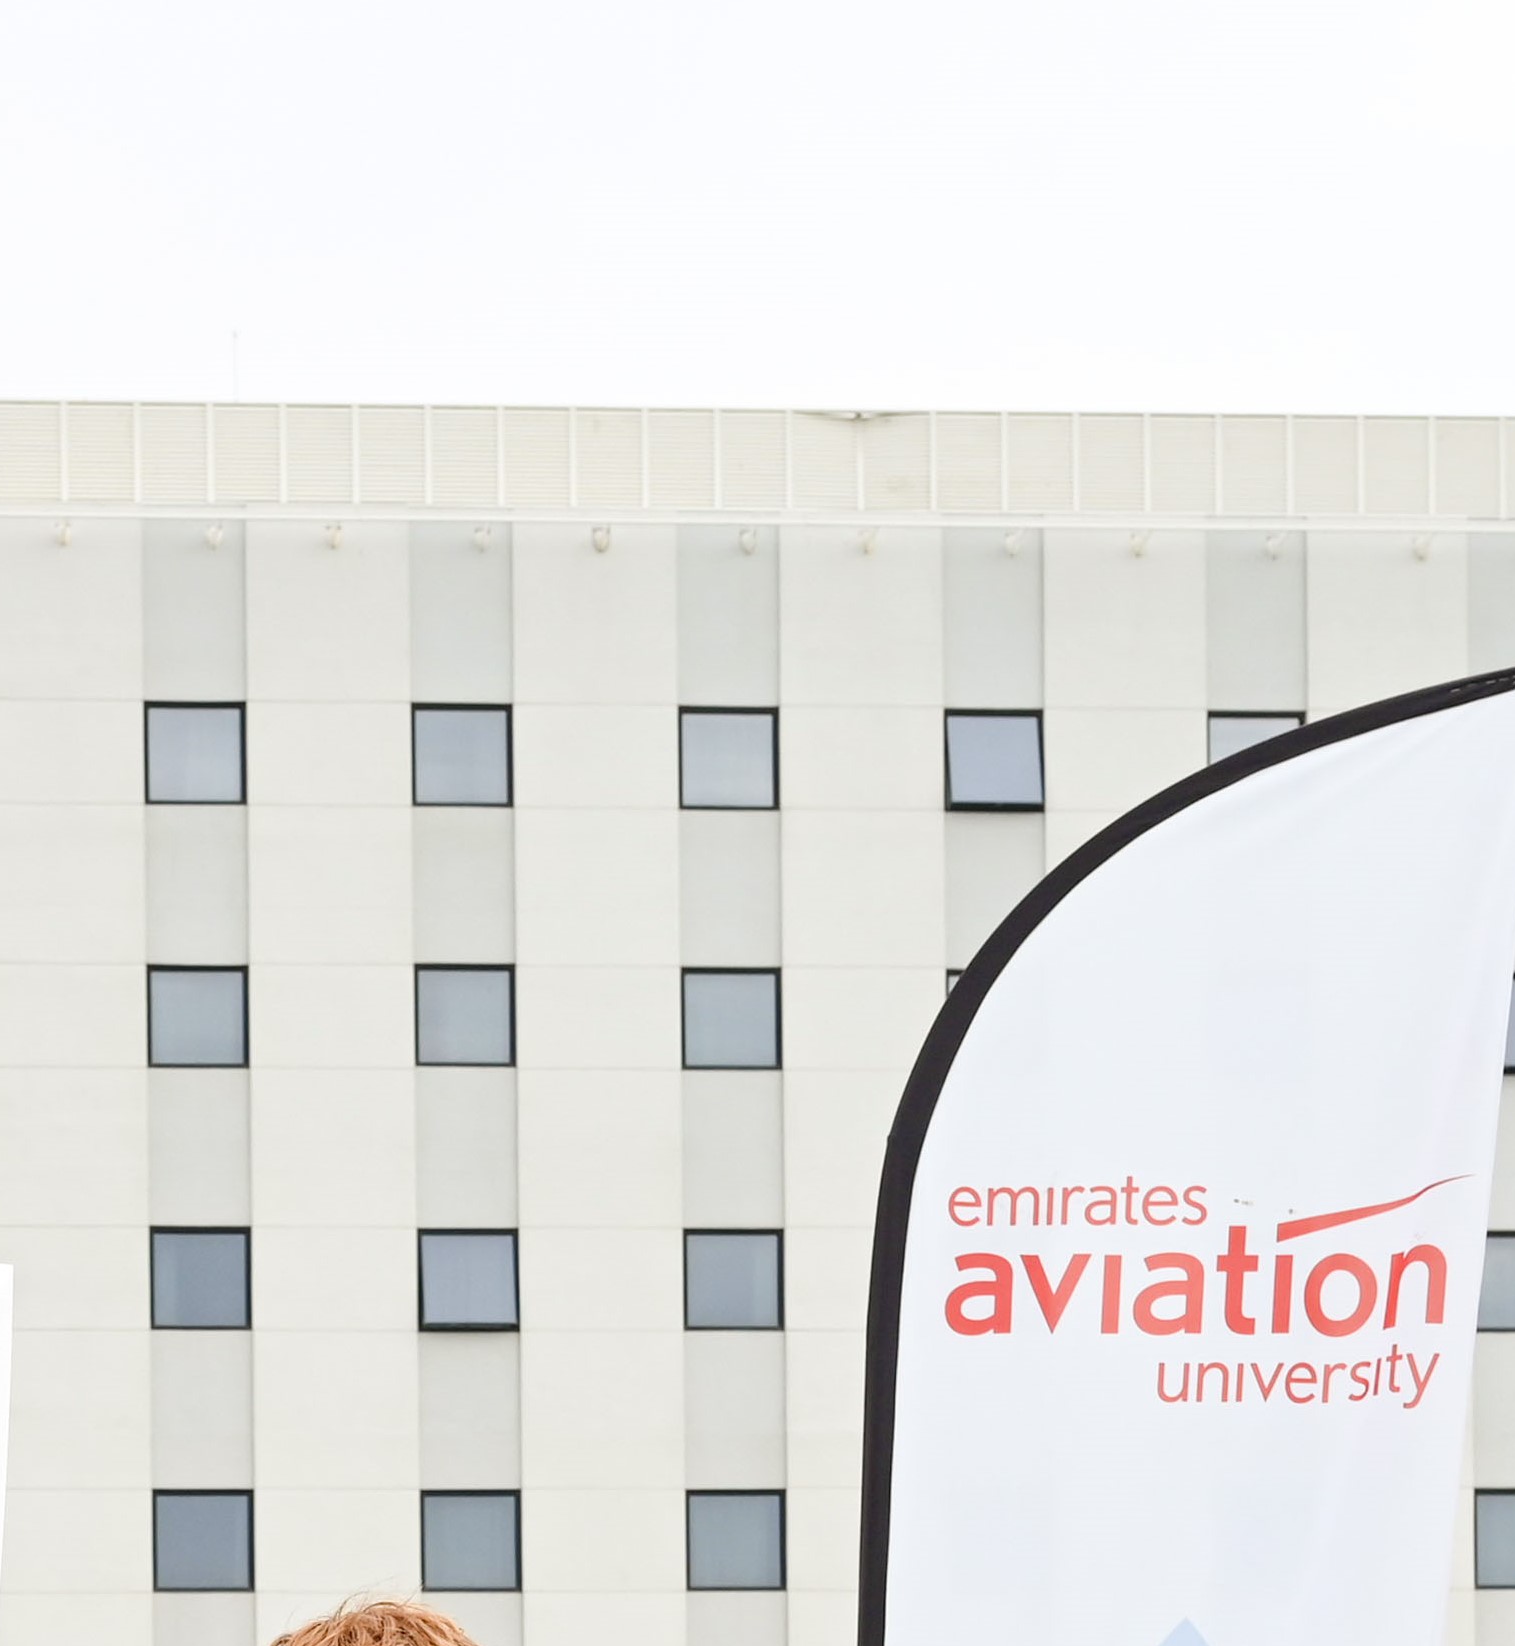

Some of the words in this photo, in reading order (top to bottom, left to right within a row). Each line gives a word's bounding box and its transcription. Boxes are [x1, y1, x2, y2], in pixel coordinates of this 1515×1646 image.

[947, 1175, 1209, 1227] emirates
[944, 1225, 1448, 1338] aviation
[1156, 1343, 1441, 1410] university
